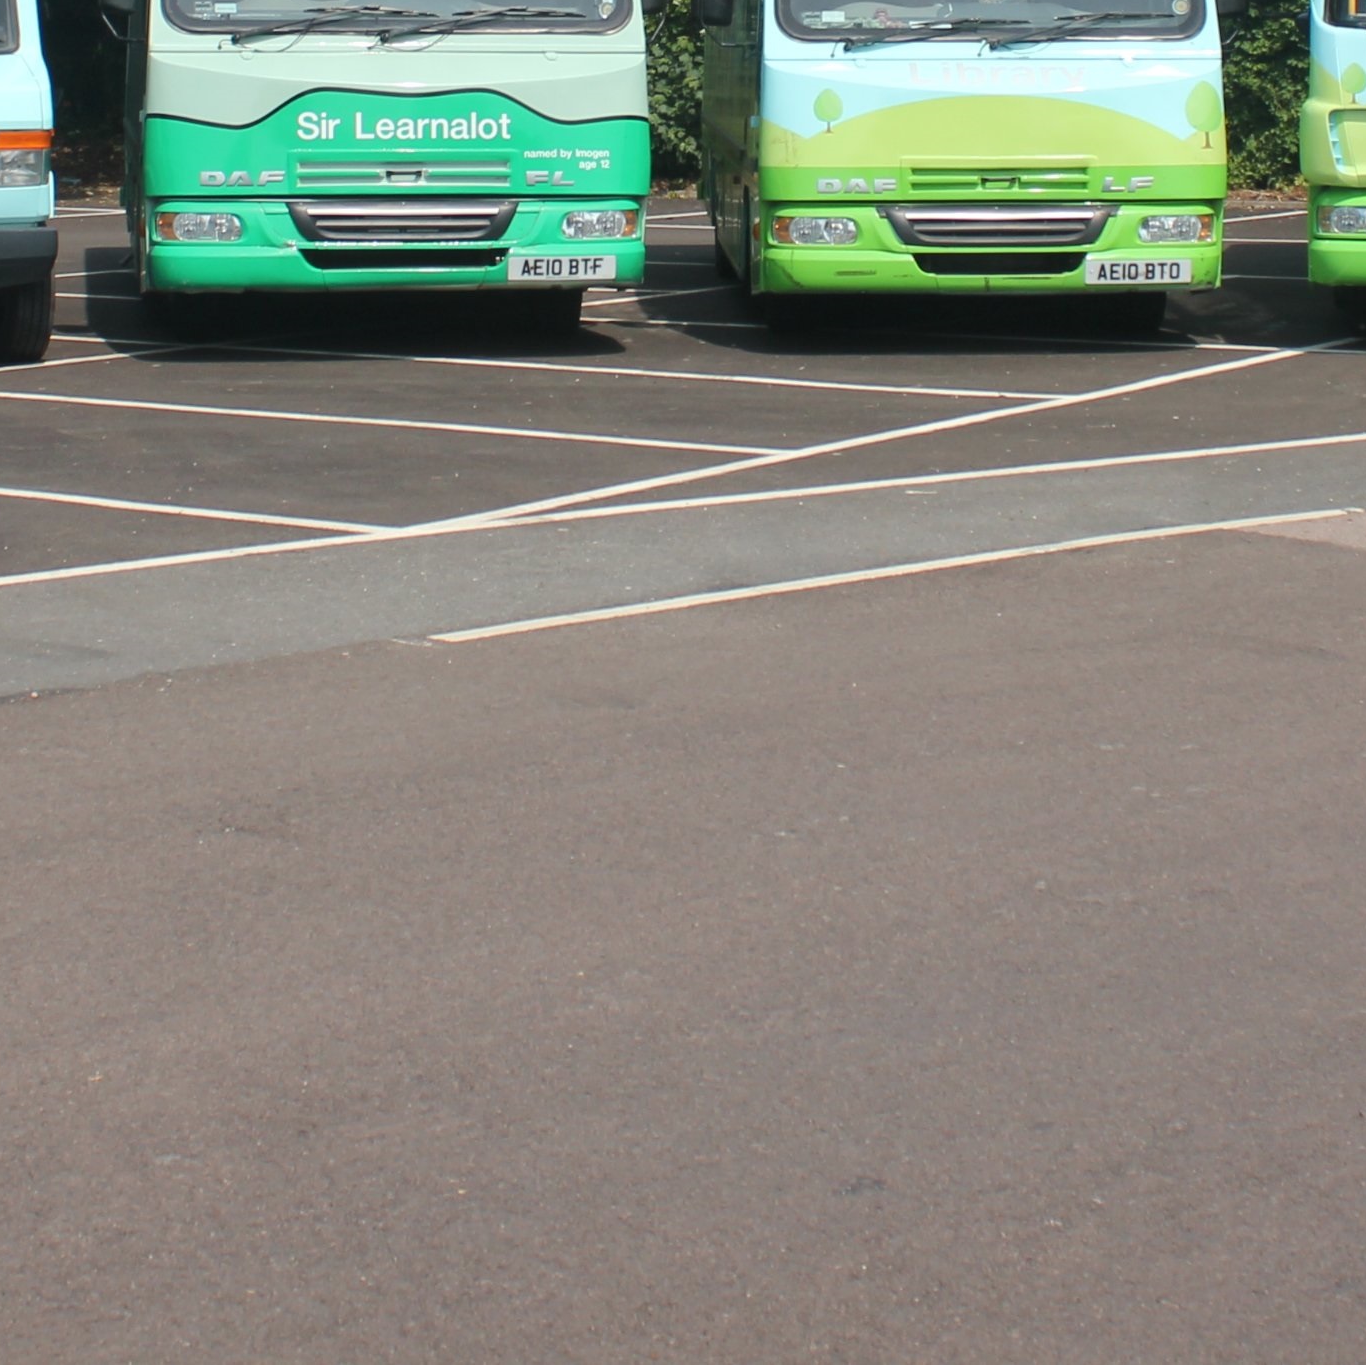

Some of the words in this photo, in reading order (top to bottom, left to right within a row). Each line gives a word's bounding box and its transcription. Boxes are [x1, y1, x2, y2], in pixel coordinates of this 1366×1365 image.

[908, 61, 1085, 94] Library
[296, 111, 341, 140] Sir
[354, 111, 512, 140] Learnalot
[523, 149, 557, 158] named
[559, 149, 573, 160] by
[575, 148, 610, 160] Imogen
[578, 161, 597, 171] age
[600, 159, 610, 169] 12
[199, 170, 285, 187] DAF
[817, 178, 899, 194] DAF
[1101, 176, 1155, 193] LF
[521, 258, 563, 276] AE10
[568, 257, 604, 276] BTF
[1097, 263, 1139, 281] AE10
